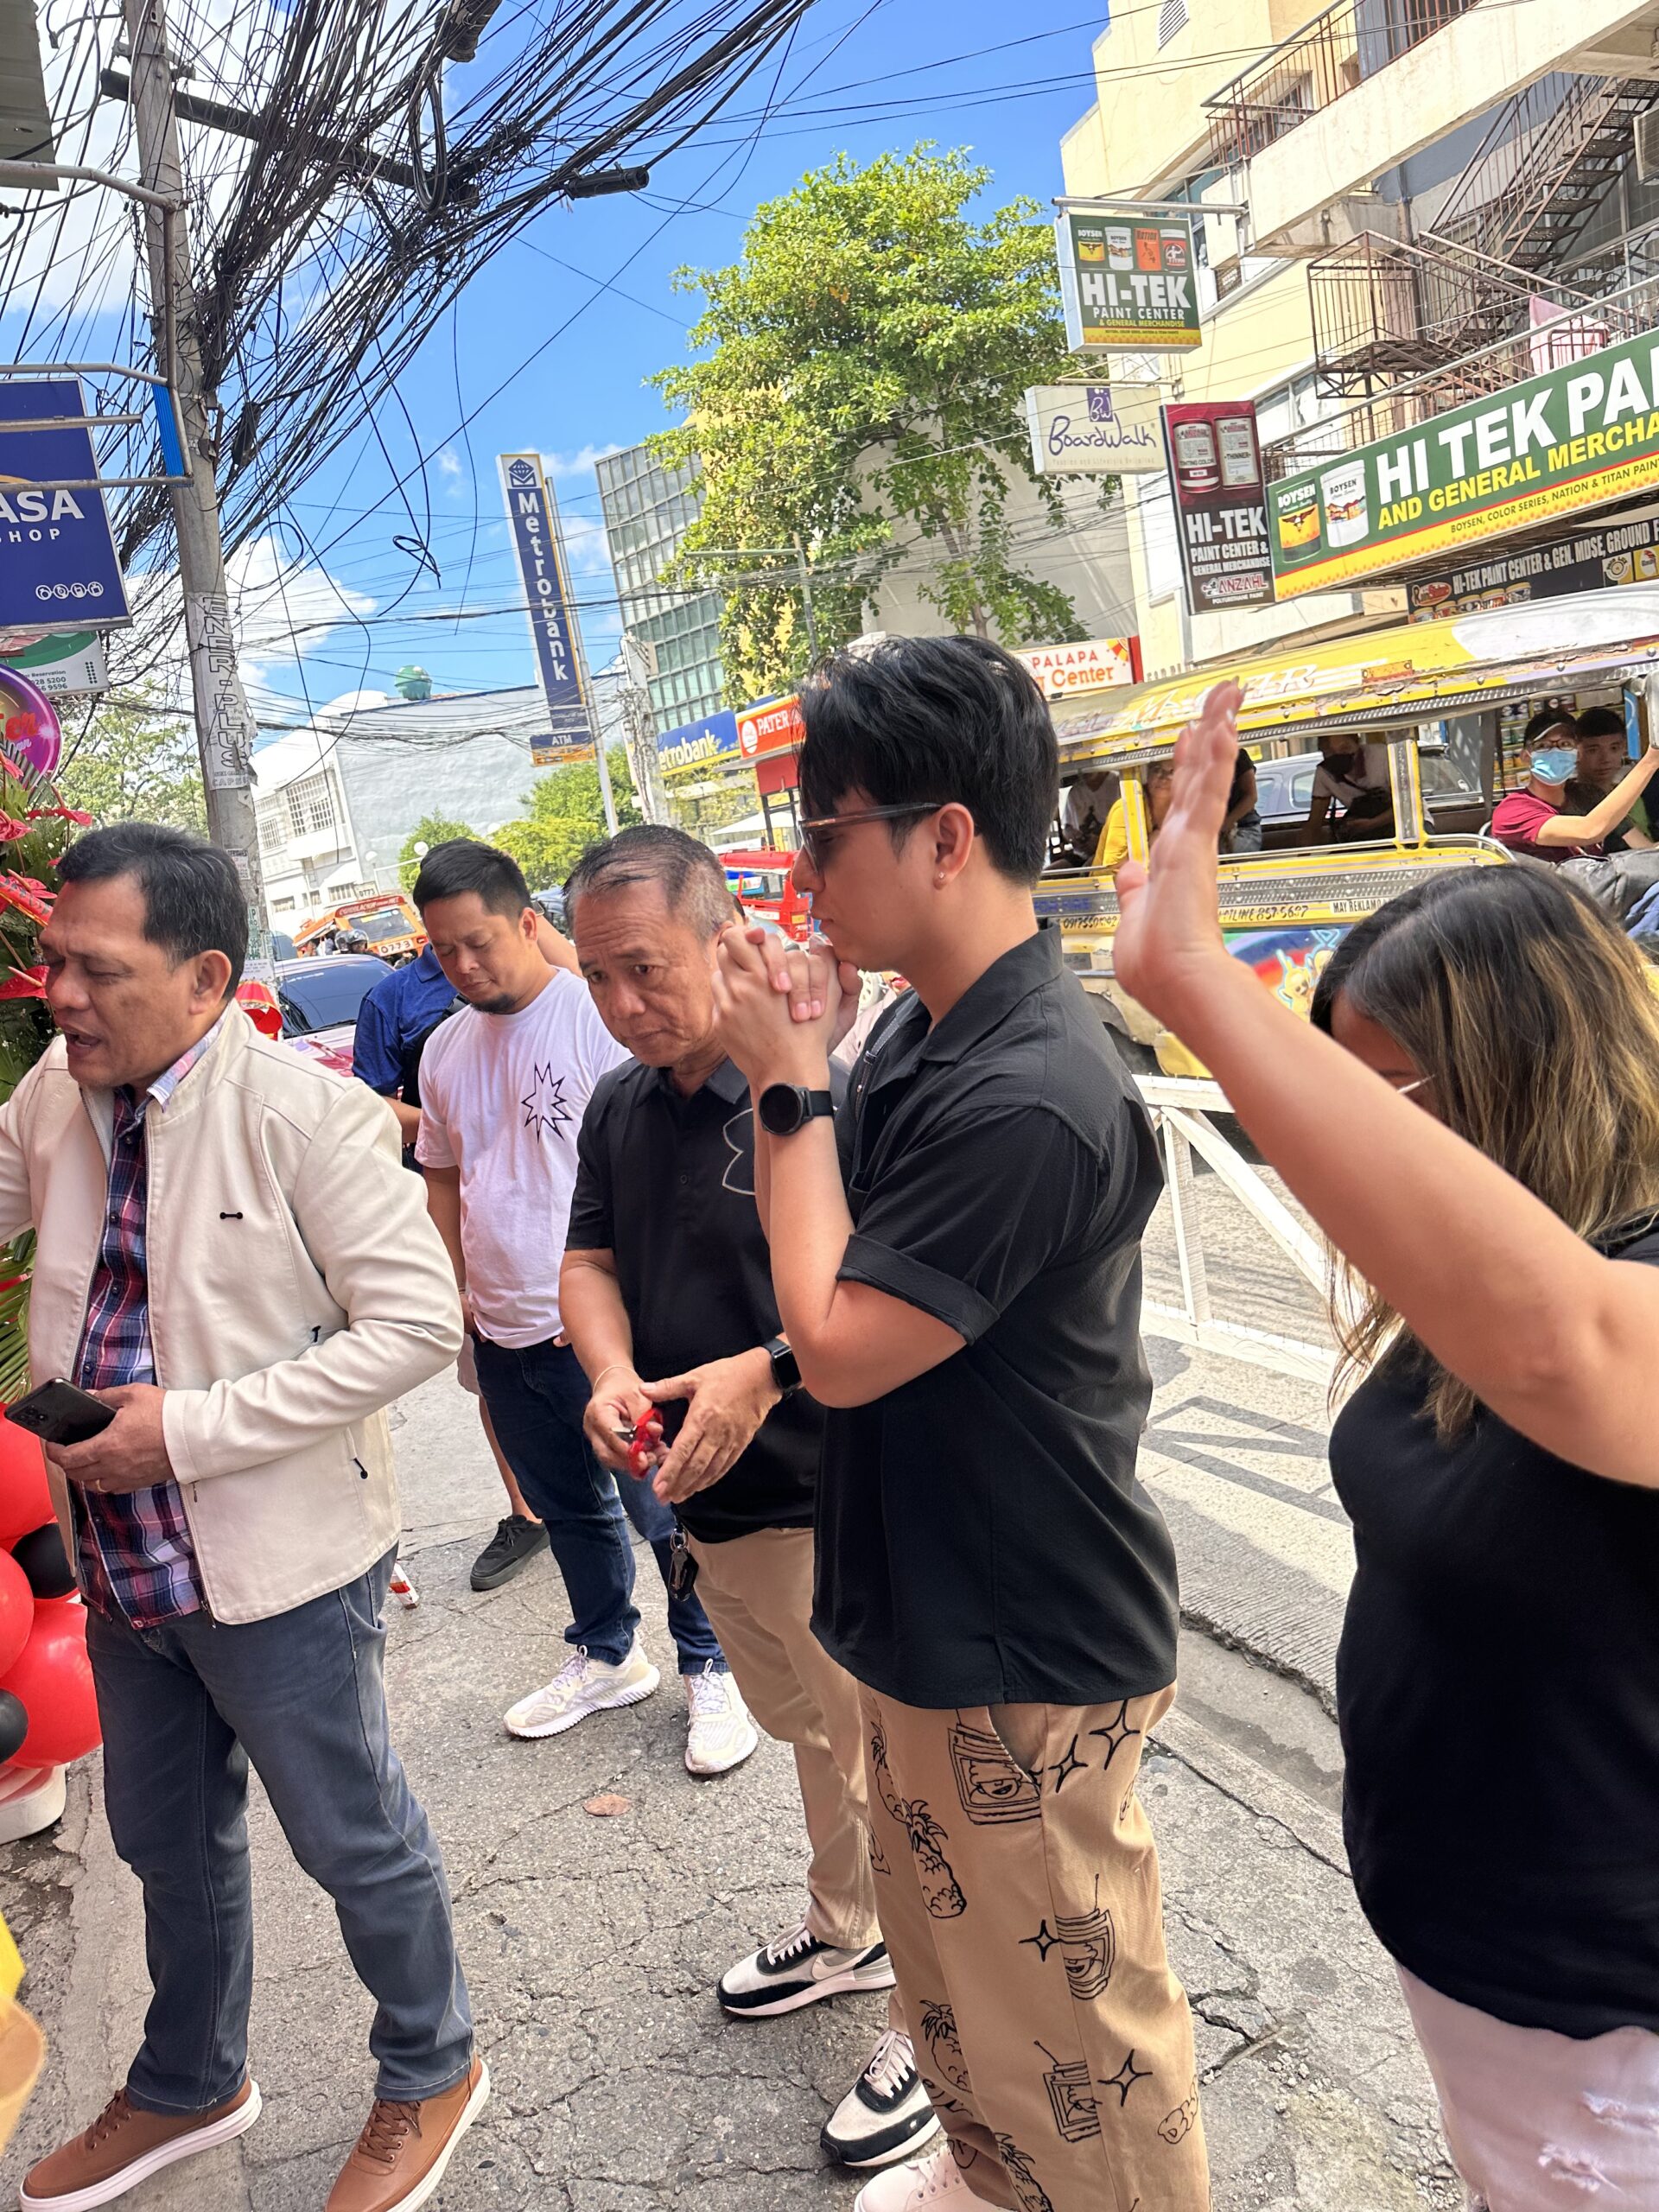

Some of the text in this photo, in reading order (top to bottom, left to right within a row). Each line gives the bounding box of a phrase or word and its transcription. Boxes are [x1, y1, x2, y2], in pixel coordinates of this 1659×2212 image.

[1080, 272, 1192, 308] HI-TEK
[1093, 307, 1185, 320] PAINT CENTER
[1376, 438, 1430, 505] HI
[1438, 387, 1558, 480] TEK
[1277, 483, 1317, 508] BOYSEN
[1330, 478, 1357, 494] BOYSEN
[1377, 495, 1423, 531] AND
[1428, 455, 1541, 512] GENERAL
[1450, 515, 1486, 534] BOYSEN,
[1487, 505, 1516, 522] COLOR
[1518, 496, 1550, 512] SERIES,
[1551, 481, 1589, 502] NATION
[1592, 478, 1599, 488] &
[1601, 467, 1630, 486] TITAN
[0, 528, 60, 543] HOP
[1185, 506, 1268, 544] HI-TEK
[1190, 540, 1269, 563] PAINT CENTER &
[1452, 572, 1483, 595] HI-TEK
[1481, 563, 1508, 587] PAINT
[1508, 552, 1543, 581] CENTER
[1543, 553, 1553, 570] &
[1552, 543, 1575, 569] GEN.
[1605, 522, 1651, 554] GROUND
[1192, 556, 1271, 576] GENERAL MERCHANDISE
[518, 492, 569, 682] Metrobank
[1218, 573, 1268, 594] ANZAHL
[1031, 649, 1099, 670] PALAPA
[48, 683, 68, 691] 9596
[1051, 666, 1116, 689] Center
[756, 710, 790, 736] PATER
[551, 734, 573, 746] ATM
[658, 728, 719, 772] etrobank
[1332, 902, 1348, 913] MAY
[380, 940, 411, 954] 0773
